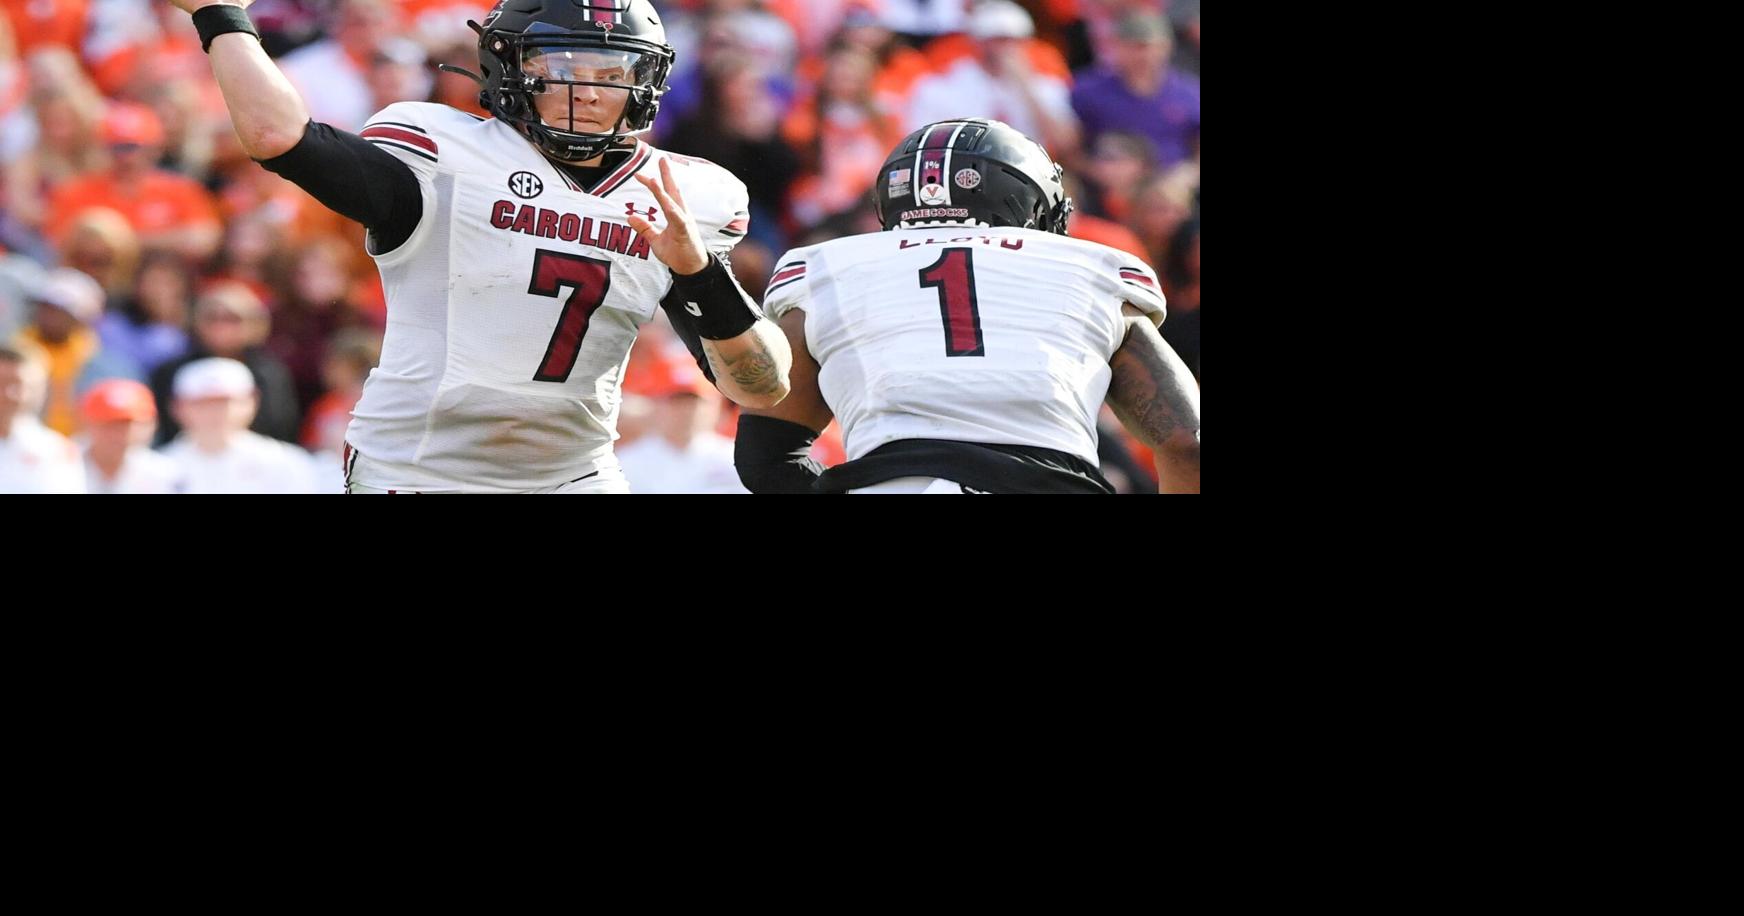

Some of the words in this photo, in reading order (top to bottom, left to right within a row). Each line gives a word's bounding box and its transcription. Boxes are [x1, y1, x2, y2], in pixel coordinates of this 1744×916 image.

[923, 160, 940, 170] 1%
[509, 172, 542, 198] SEC
[956, 169, 980, 188] SEC
[901, 207, 969, 220] GAMECOCKS
[490, 200, 651, 260] CAROLINA
[918, 246, 985, 357] 1
[527, 248, 611, 383] 7
